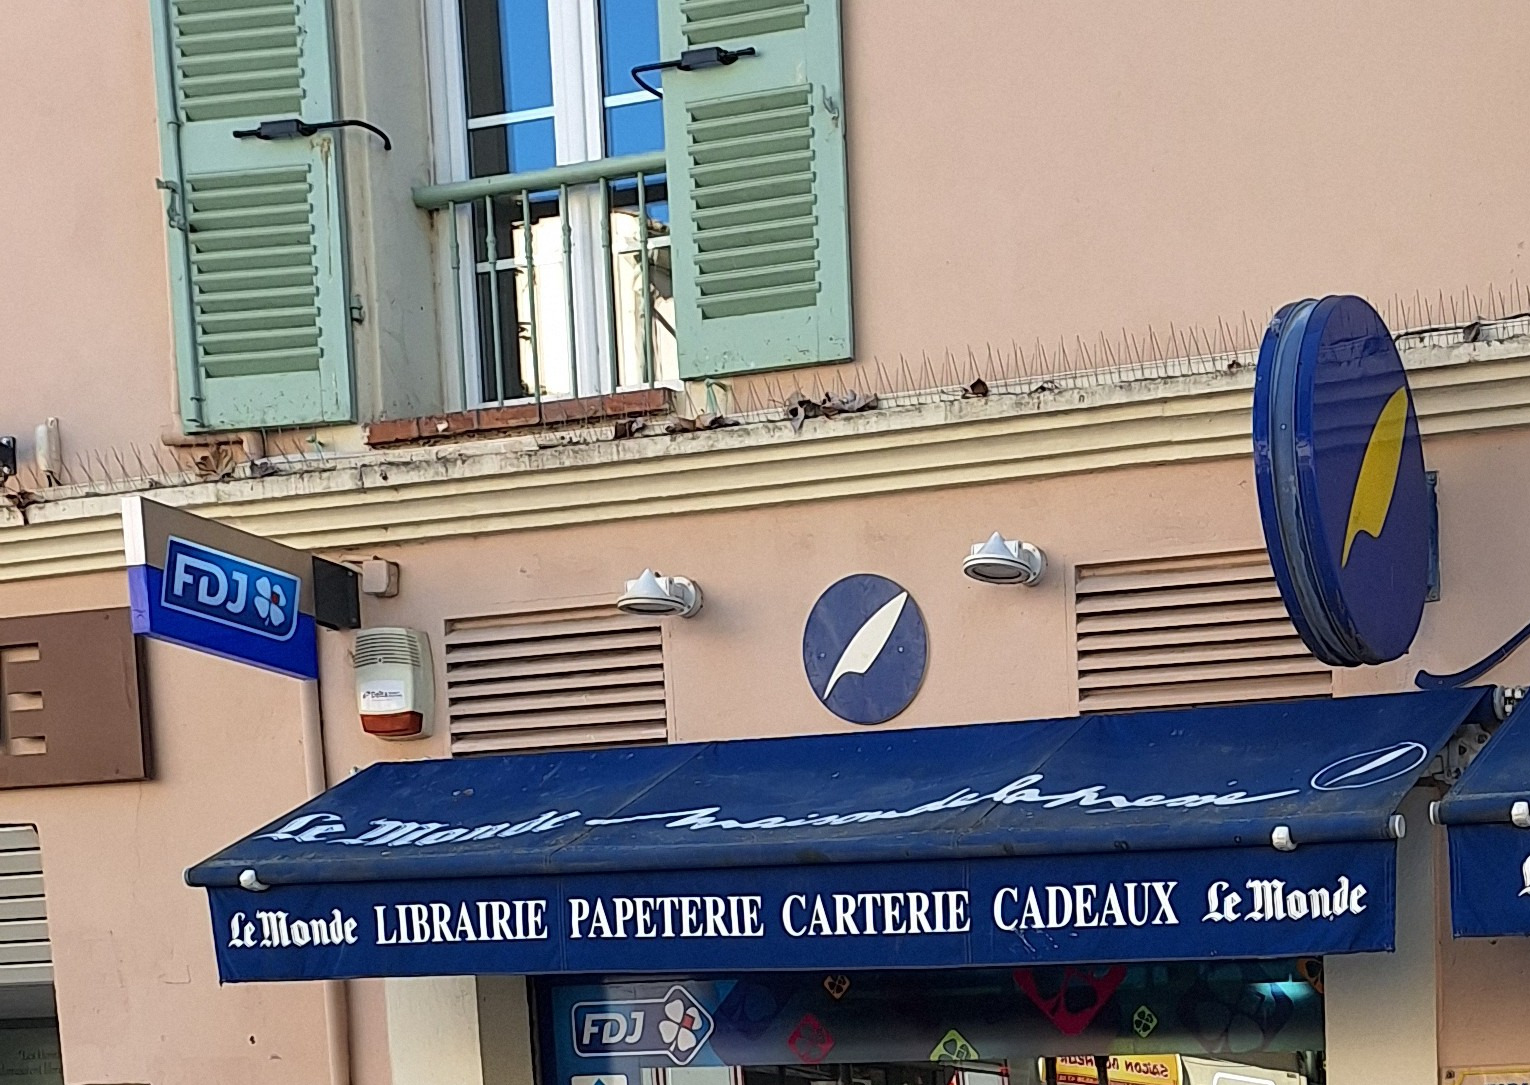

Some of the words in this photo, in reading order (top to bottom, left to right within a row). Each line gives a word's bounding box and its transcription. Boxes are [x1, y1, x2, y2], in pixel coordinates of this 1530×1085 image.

[171, 552, 249, 615] FDJ
[343, 809, 581, 848] Monde
[373, 899, 549, 946] LIBRAIRIE
[568, 895, 765, 940] PAPETERIE
[781, 889, 971, 937] CARTERIE
[992, 881, 1180, 932] CADEAUX
[1202, 880, 1243, 924] Le
[1243, 876, 1368, 923] Monde
[227, 913, 257, 949] Le
[253, 908, 359, 948] Monde
[581, 1011, 645, 1046] FDJ
